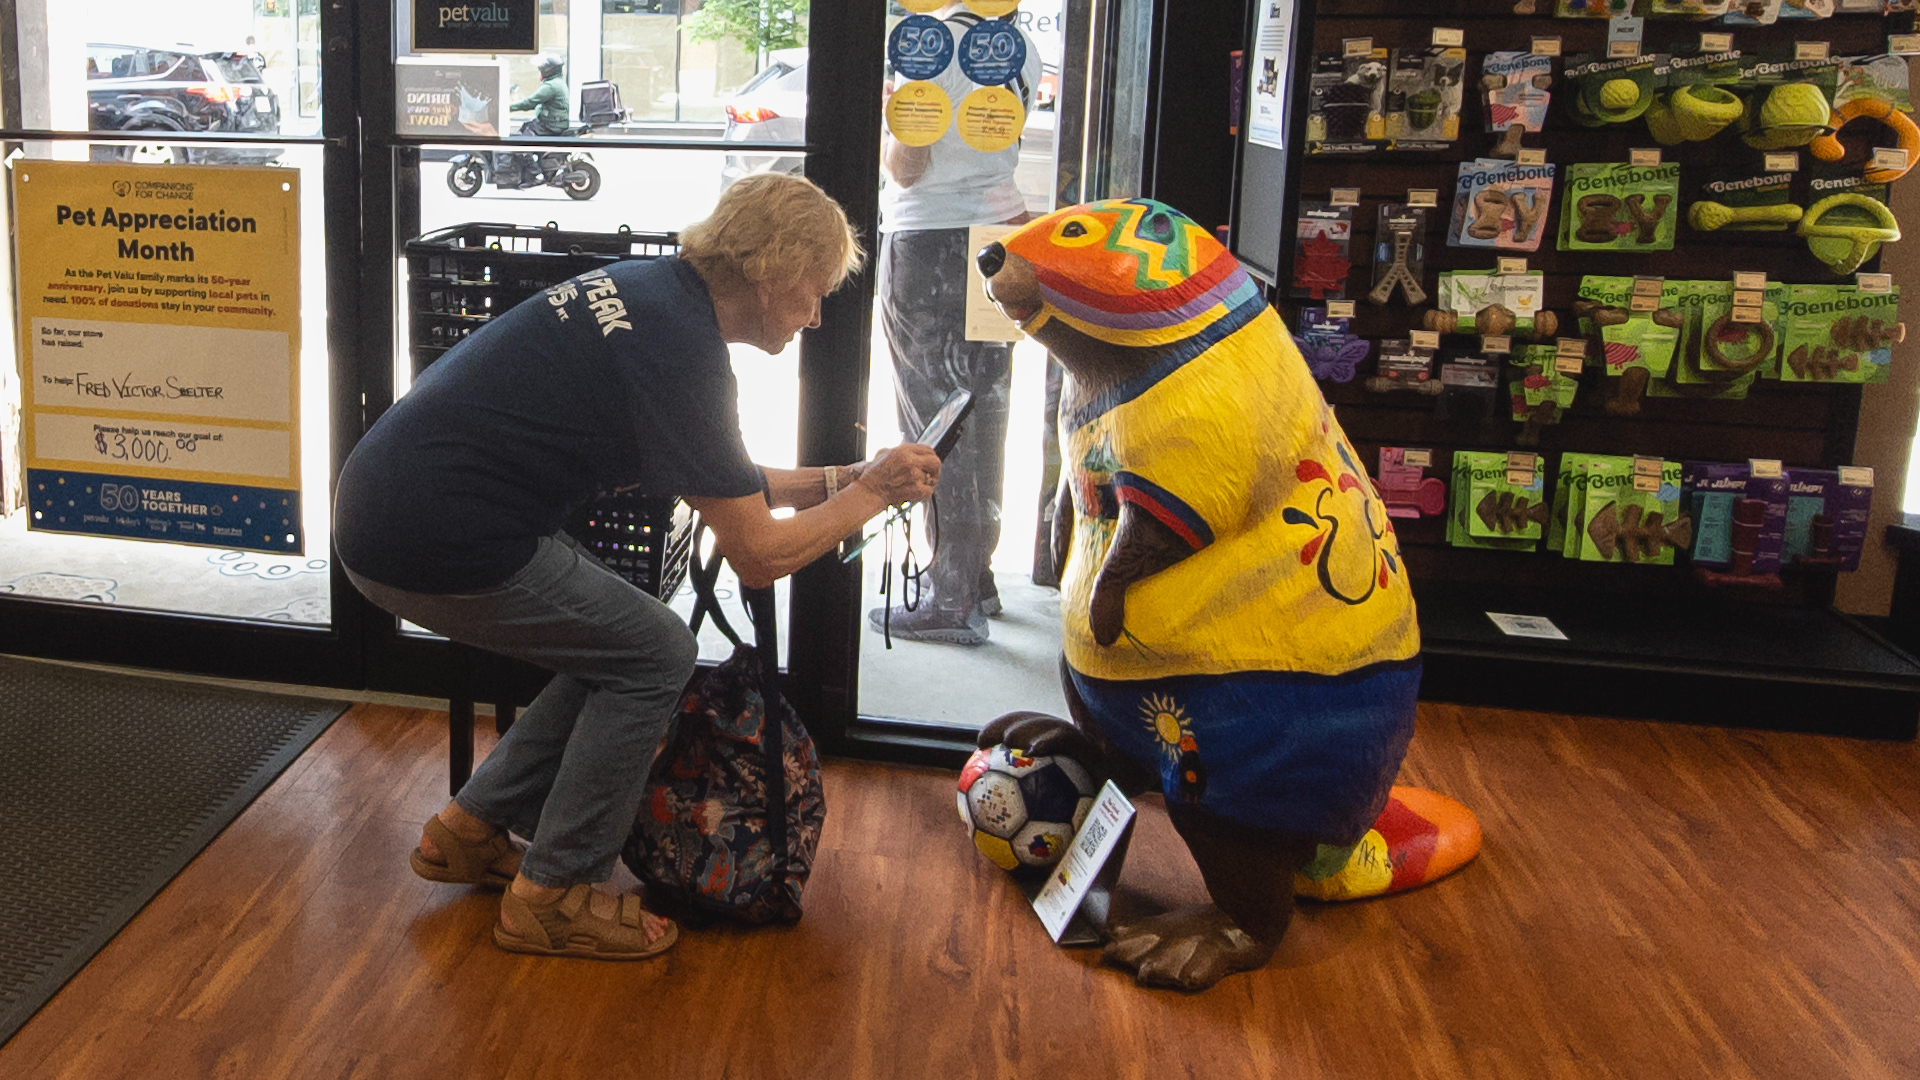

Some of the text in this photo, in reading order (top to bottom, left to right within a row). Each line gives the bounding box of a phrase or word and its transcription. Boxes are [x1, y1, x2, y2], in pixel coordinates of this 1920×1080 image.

[898, 26, 944, 57] 50
[969, 32, 1015, 62] 50
[1484, 57, 1551, 73] Benebone
[1670, 49, 1742, 69] Benebone
[134, 181, 195, 192] COMPANIONS
[1473, 166, 1555, 187] Benebone
[1574, 165, 1680, 192] Benebone
[1711, 173, 1792, 193] Benebone
[135, 190, 194, 200] FOR CHANGE
[56, 204, 97, 227] Pet
[101, 206, 257, 234] Appreciation
[117, 238, 195, 262] Month
[65, 268, 251, 287] As the Pet Valu family marks its 50-year
[107, 285, 125, 295] join
[127, 287, 139, 295] us
[141, 286, 153, 297] by
[154, 288, 207, 300] supporting
[209, 289, 233, 299] local
[236, 291, 259, 301] pets
[261, 292, 270, 301] in
[71, 296, 95, 306] 100%
[98, 298, 109, 306] of
[110, 298, 159, 310] donations
[161, 301, 180, 312] stay
[182, 302, 192, 310] in
[193, 305, 215, 314] your
[217, 304, 276, 318] community.
[1788, 293, 1900, 316] Benebone
[43, 375, 53, 383] To
[76, 372, 224, 399] FRED VICTOR SHELTER
[93, 423, 120, 433] Please
[121, 426, 140, 436] help
[153, 430, 176, 438] reach
[178, 432, 192, 440] our
[101, 483, 139, 513] 50
[141, 489, 182, 502] YEARS
[141, 500, 208, 516] TOGETHER
